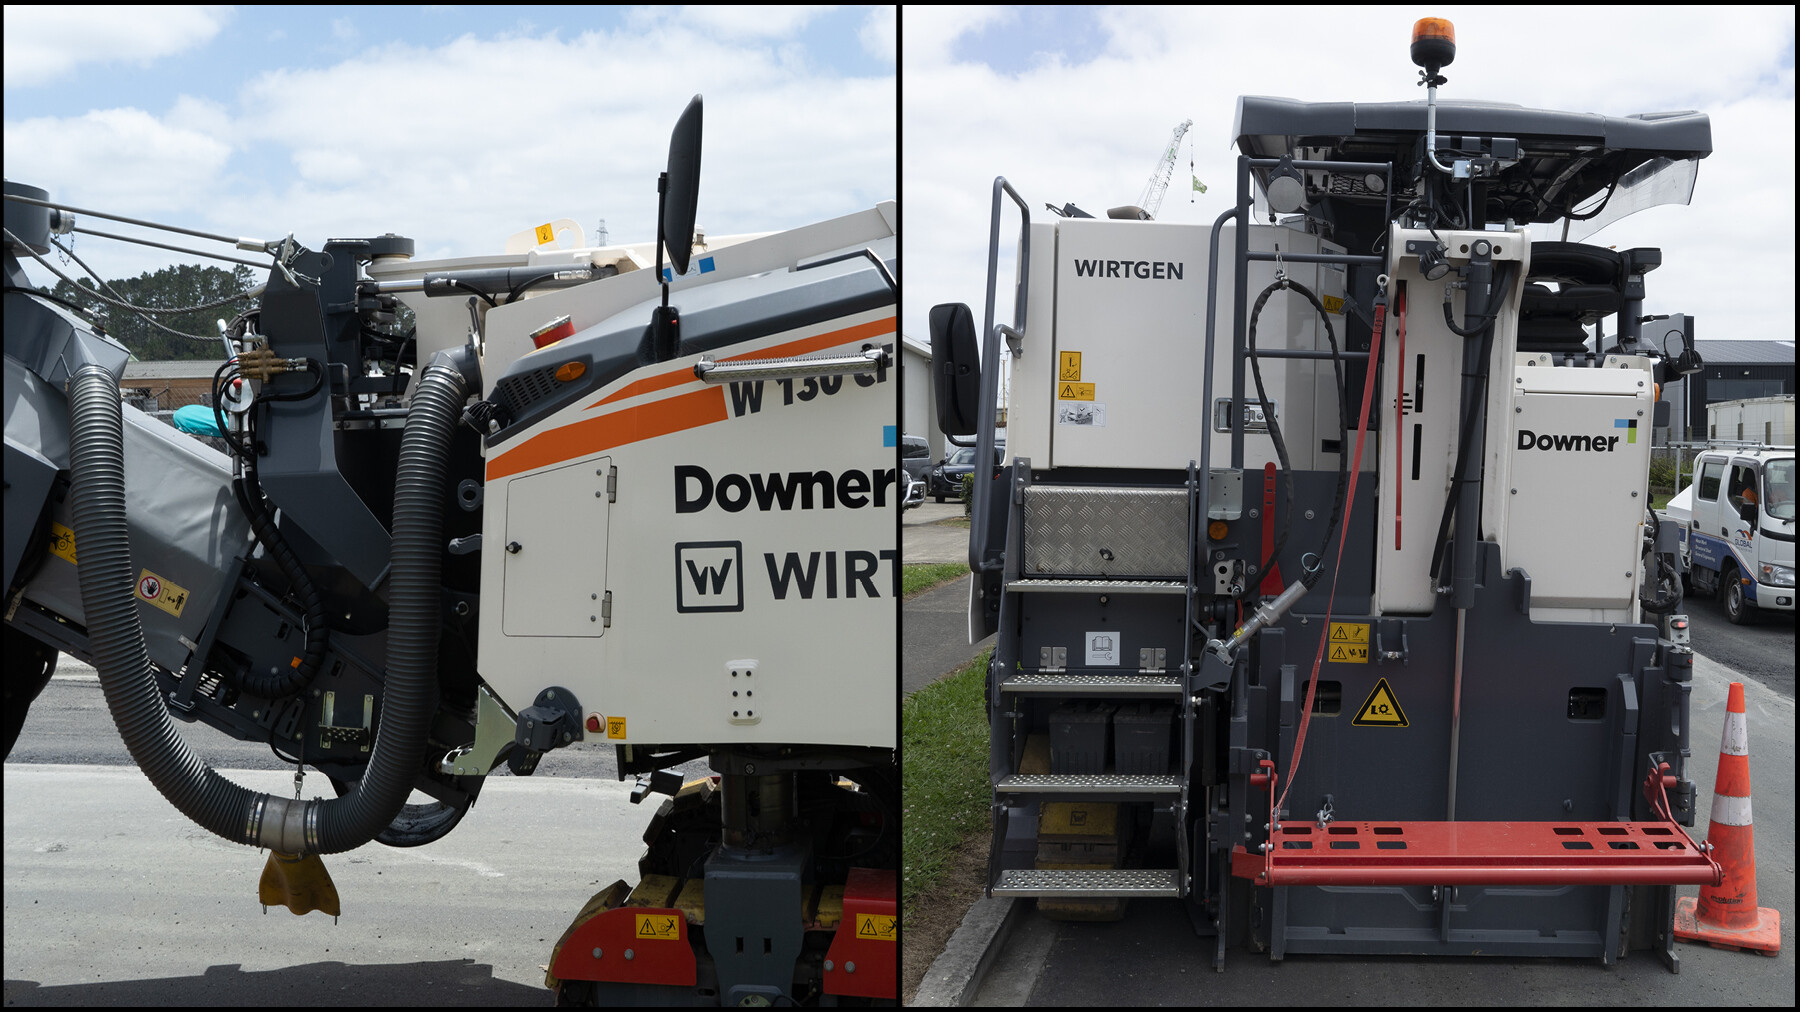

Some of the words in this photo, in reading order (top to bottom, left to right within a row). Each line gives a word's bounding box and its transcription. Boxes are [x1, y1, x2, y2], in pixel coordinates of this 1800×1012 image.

[1074, 259, 1183, 280] WIRTGEN
[729, 380, 764, 417] W
[776, 374, 843, 406] 130
[1518, 430, 1619, 452] Downer
[674, 465, 896, 513] Downer
[1735, 538, 1752, 549] GLOBAL
